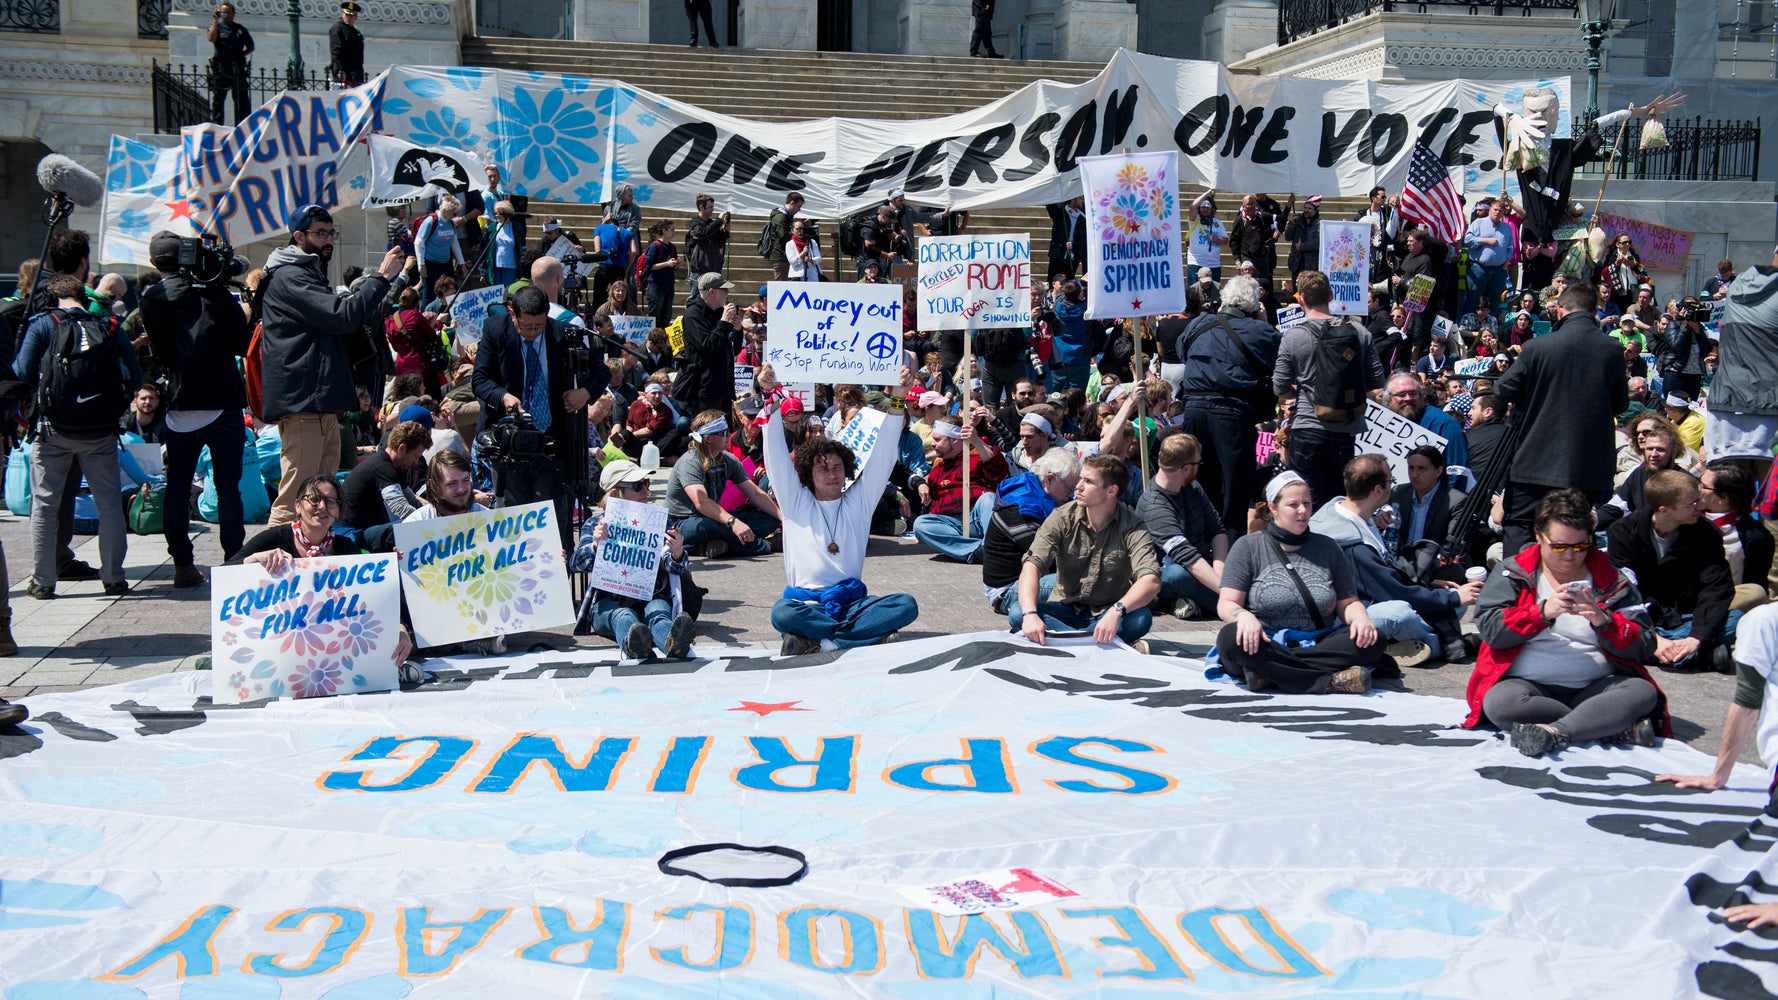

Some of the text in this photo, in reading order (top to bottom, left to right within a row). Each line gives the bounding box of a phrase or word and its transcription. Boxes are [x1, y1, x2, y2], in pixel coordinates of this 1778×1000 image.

[647, 122, 826, 191] ONE
[846, 85, 1148, 197] PERSON.
[1174, 94, 1296, 164] ONE
[187, 160, 338, 245] SPRING
[1602, 215, 1643, 234] WEAPONS
[1648, 225, 1678, 242] LOBBY
[920, 240, 1030, 263] CORRUPTION
[1102, 239, 1169, 261] DEMOCRACY
[1653, 241, 1676, 255] WAR
[967, 262, 1030, 290] ROME
[1104, 260, 1171, 293] SPRING
[1330, 271, 1360, 282] DEMOCRACY
[453, 288, 503, 316] EQUAL VOICE
[1330, 284, 1360, 301] SPRING
[469, 306, 484, 320] FOR
[775, 289, 901, 327] Money out
[927, 297, 1013, 320] YOUR TOGA IS
[982, 312, 1030, 322] SHOWING
[629, 319, 653, 329] VOICE
[817, 315, 837, 330] of
[796, 330, 860, 352] Politics!
[784, 352, 898, 376] Stop Funding War!
[1460, 360, 1493, 374] PROTEC
[1365, 404, 1413, 439] ILED
[407, 506, 549, 572] EQUAL VOICE
[608, 525, 659, 548] SPRING IS
[447, 541, 535, 587] FOR ALL.
[603, 542, 655, 571] COMING
[220, 559, 389, 621] EQUAL VOICE
[260, 593, 366, 640] FOR ALL.
[315, 731, 1179, 796] SPRING
[92, 897, 1336, 982] DEMOCRACY
